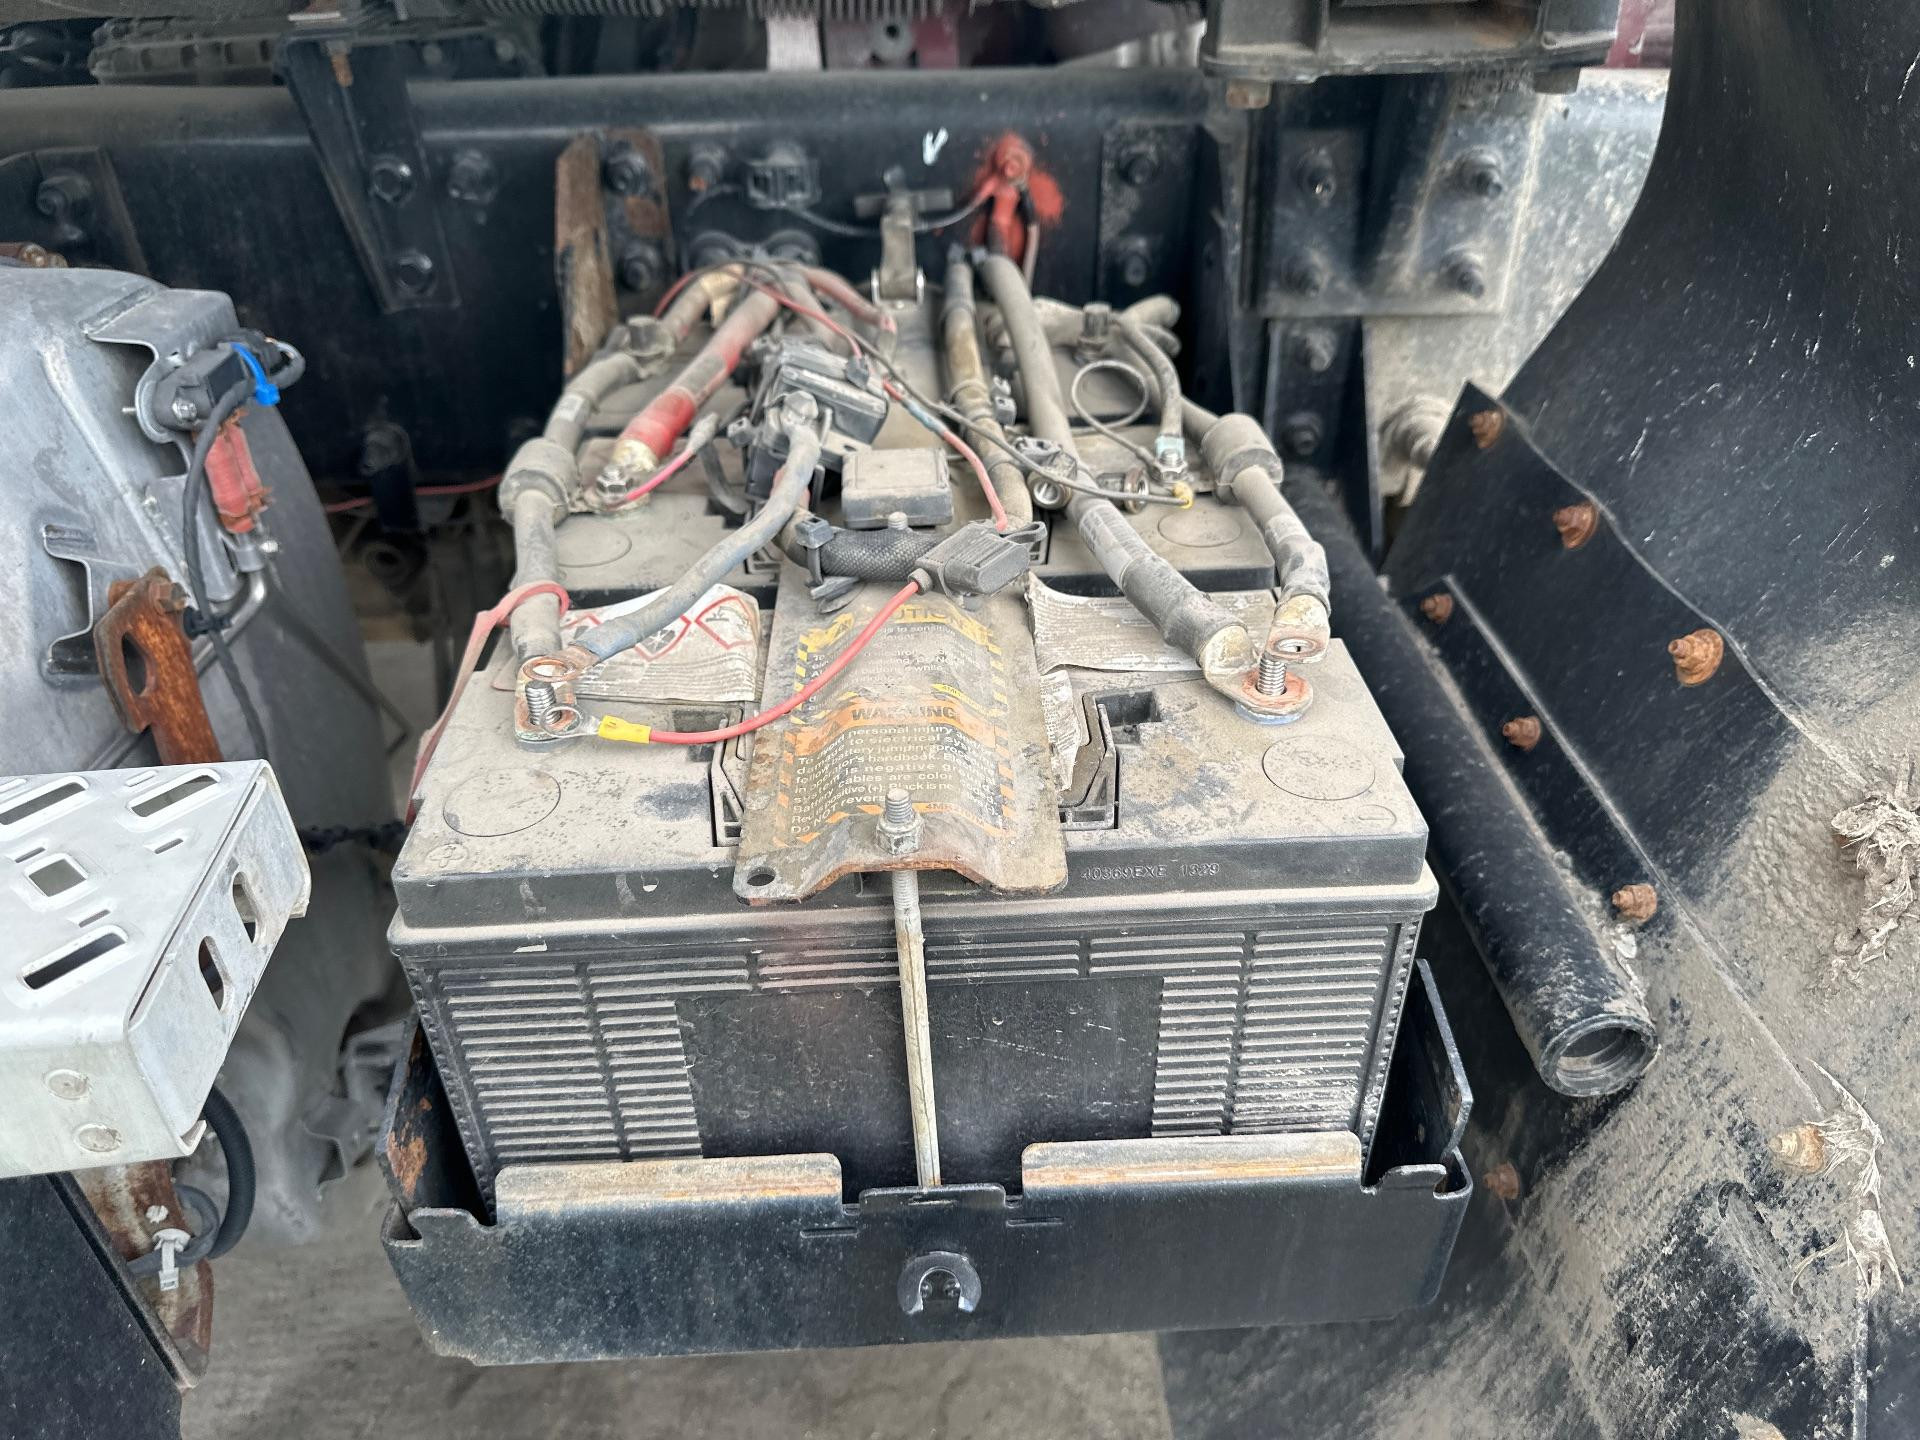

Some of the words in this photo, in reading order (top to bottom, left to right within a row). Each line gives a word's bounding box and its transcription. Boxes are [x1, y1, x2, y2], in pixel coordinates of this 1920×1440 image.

[851, 706, 957, 721] WAING
[848, 726, 909, 738] personal
[913, 725, 953, 735] injury
[796, 744, 845, 775] damage
[850, 738, 864, 746] to
[796, 763, 830, 784] follow
[845, 767, 859, 776] is
[864, 762, 935, 773] negative
[839, 774, 882, 788] cables
[889, 773, 912, 781] are
[926, 782, 937, 790] is
[795, 785, 807, 793] in
[790, 825, 810, 834] Do
[814, 803, 838, 826] NOT
